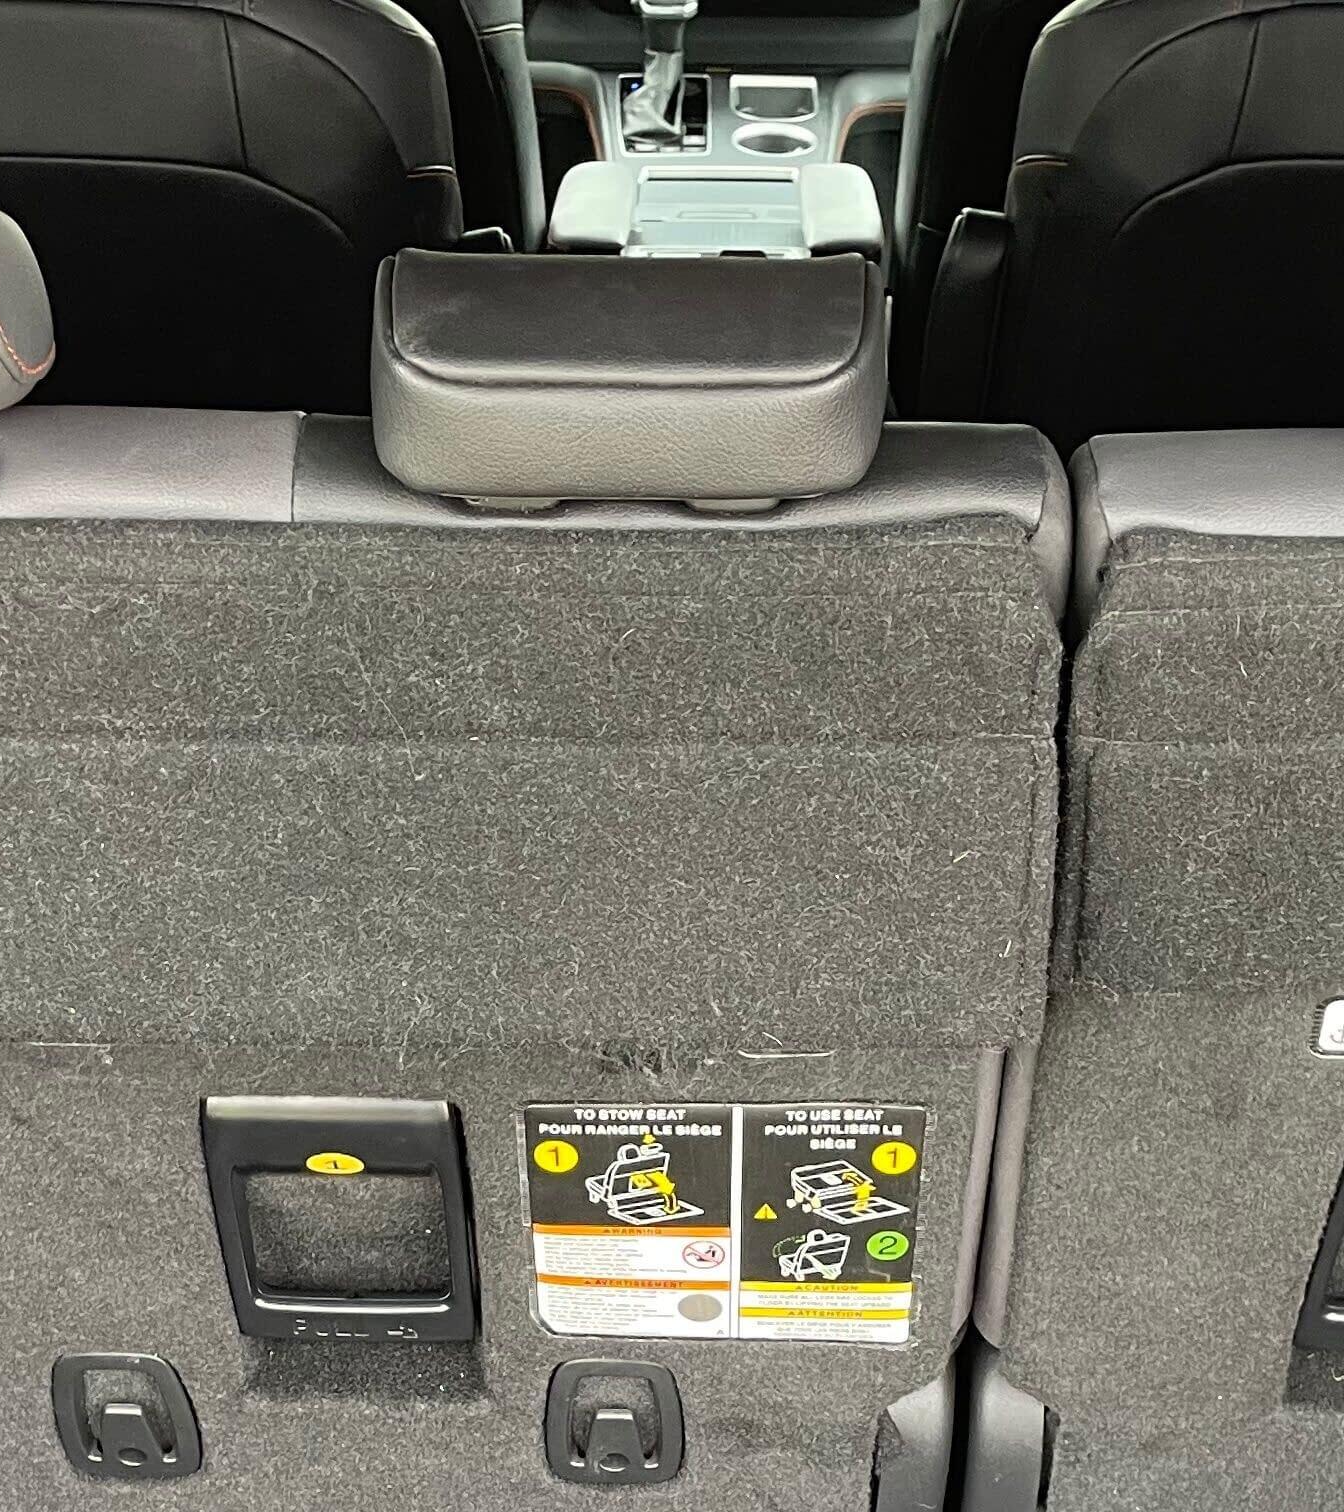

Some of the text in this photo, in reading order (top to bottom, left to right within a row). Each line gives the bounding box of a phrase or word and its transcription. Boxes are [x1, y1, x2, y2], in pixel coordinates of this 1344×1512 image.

[574, 1109, 686, 1121] TO STOW SEAT
[785, 1109, 884, 1122] TO USE SEAT
[538, 1123, 583, 1135] POUR
[585, 1124, 651, 1136] RANGER
[653, 1125, 672, 1135] LE
[764, 1124, 903, 1136] POUR UTILISER LE
[547, 1146, 560, 1167] 1
[887, 1147, 897, 1169] 1
[878, 1235, 898, 1255] 2
[795, 1310, 863, 1318] ATTENTION
